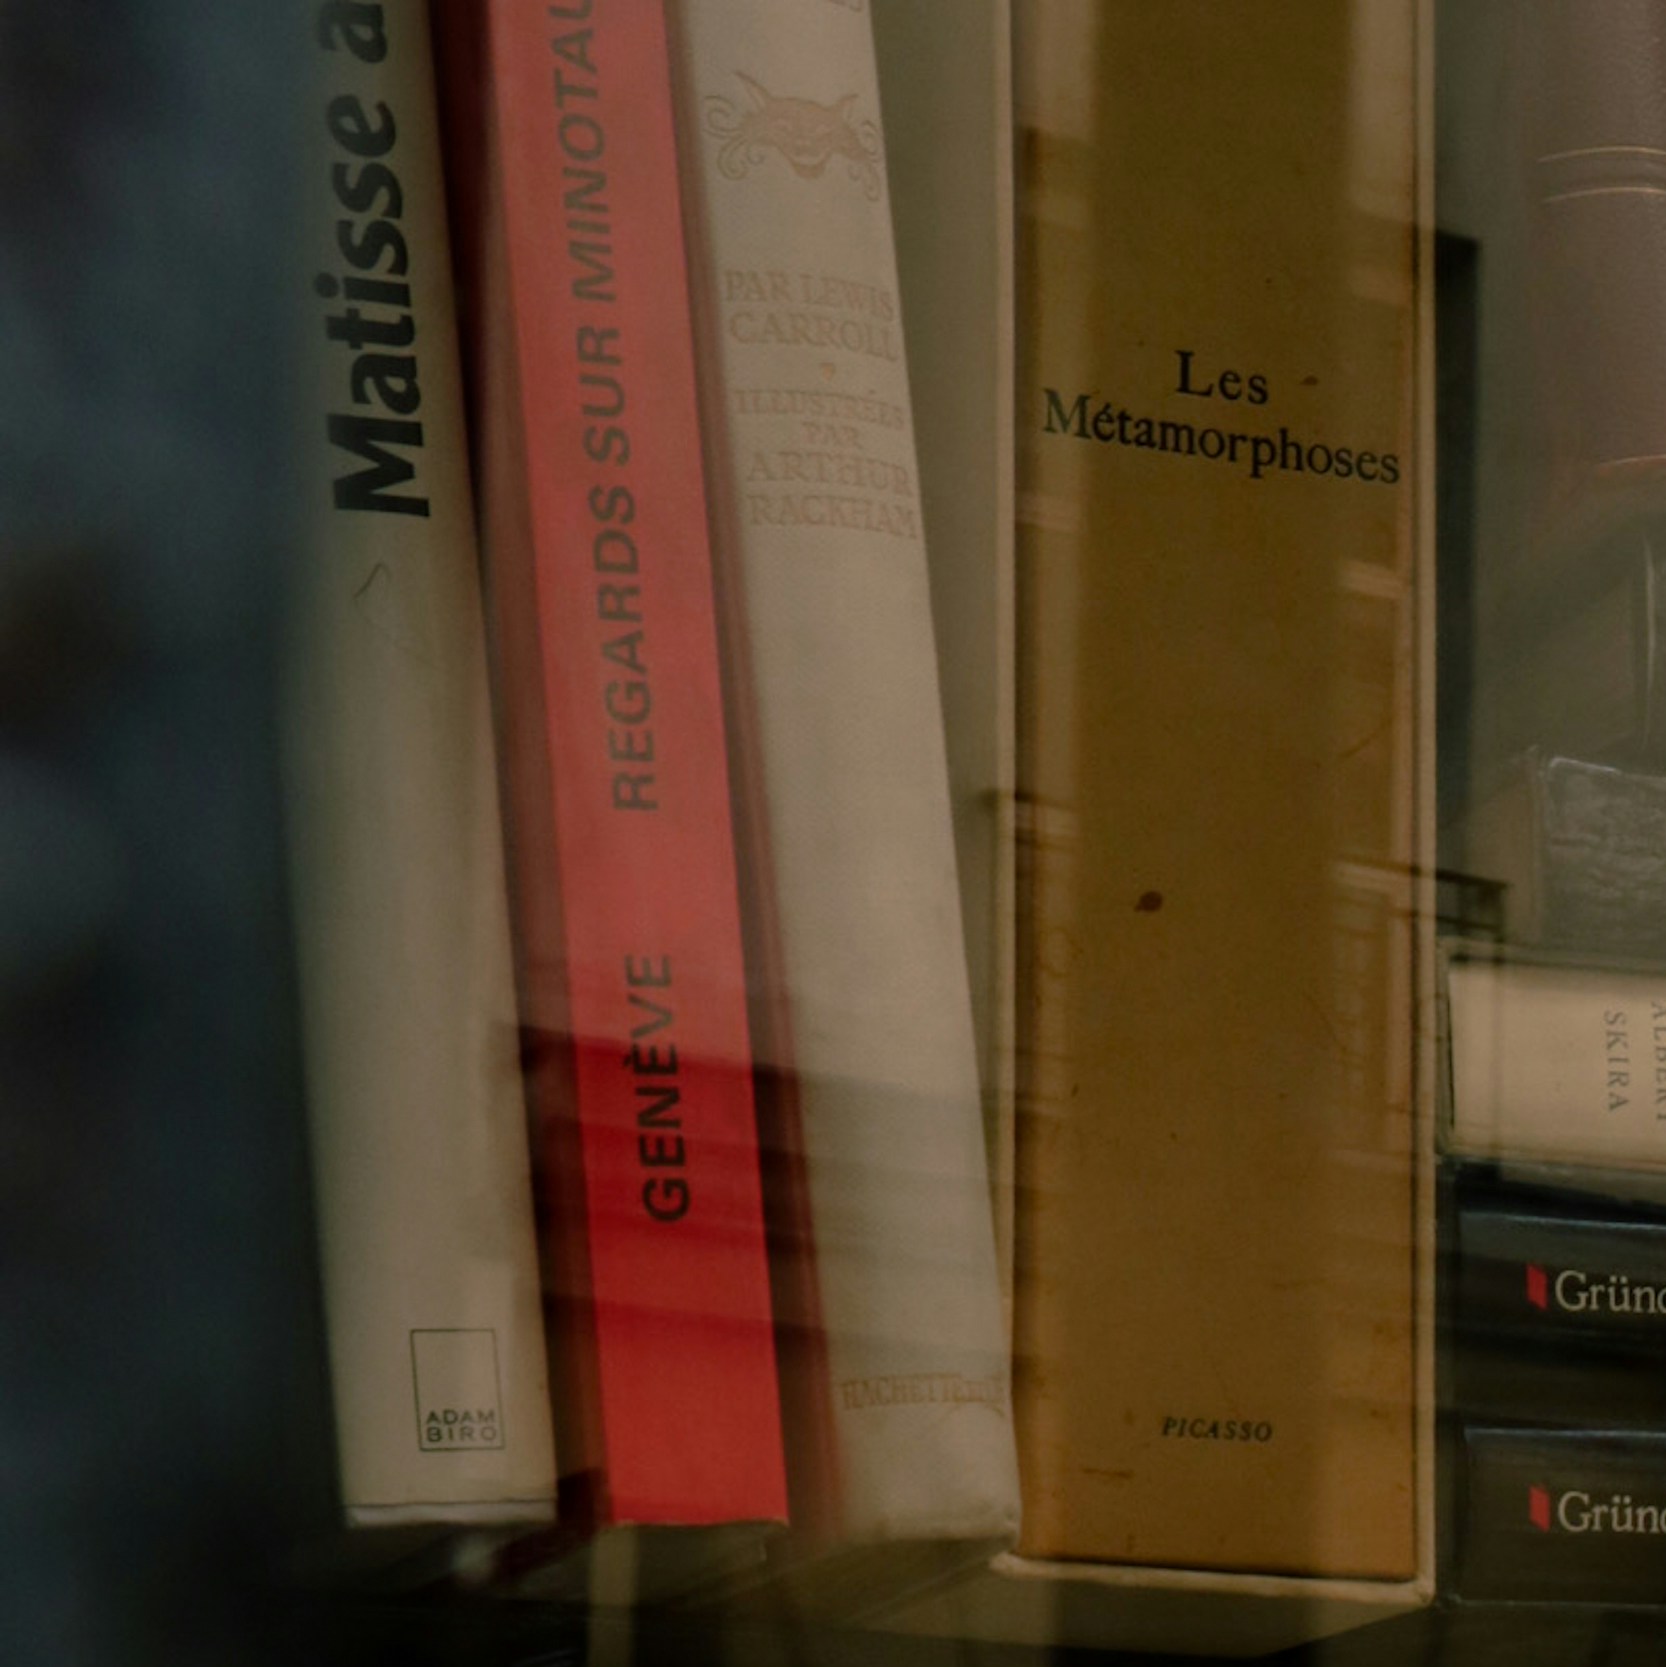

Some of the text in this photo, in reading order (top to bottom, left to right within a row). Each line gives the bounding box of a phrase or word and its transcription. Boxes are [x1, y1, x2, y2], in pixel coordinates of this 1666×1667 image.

[312, 93, 431, 518] Matisse
[725, 269, 895, 322] PAR LEWIS
[728, 310, 898, 363] CARROLL
[575, 323, 631, 468] SUR
[1174, 350, 1269, 406] Les
[802, 421, 863, 450] PAR
[1042, 388, 1401, 484] Métamorphoses
[746, 451, 913, 498] ARTHUR
[749, 492, 919, 540] RACKHAM
[587, 483, 660, 813] REGARDS
[624, 953, 690, 1223] GENÈVE
[1604, 1009, 1632, 1114] SKIRA
[426, 1409, 496, 1425] ADAM
[427, 1426, 497, 1443] BIRO
[1160, 1414, 1275, 1443] PICASSO
